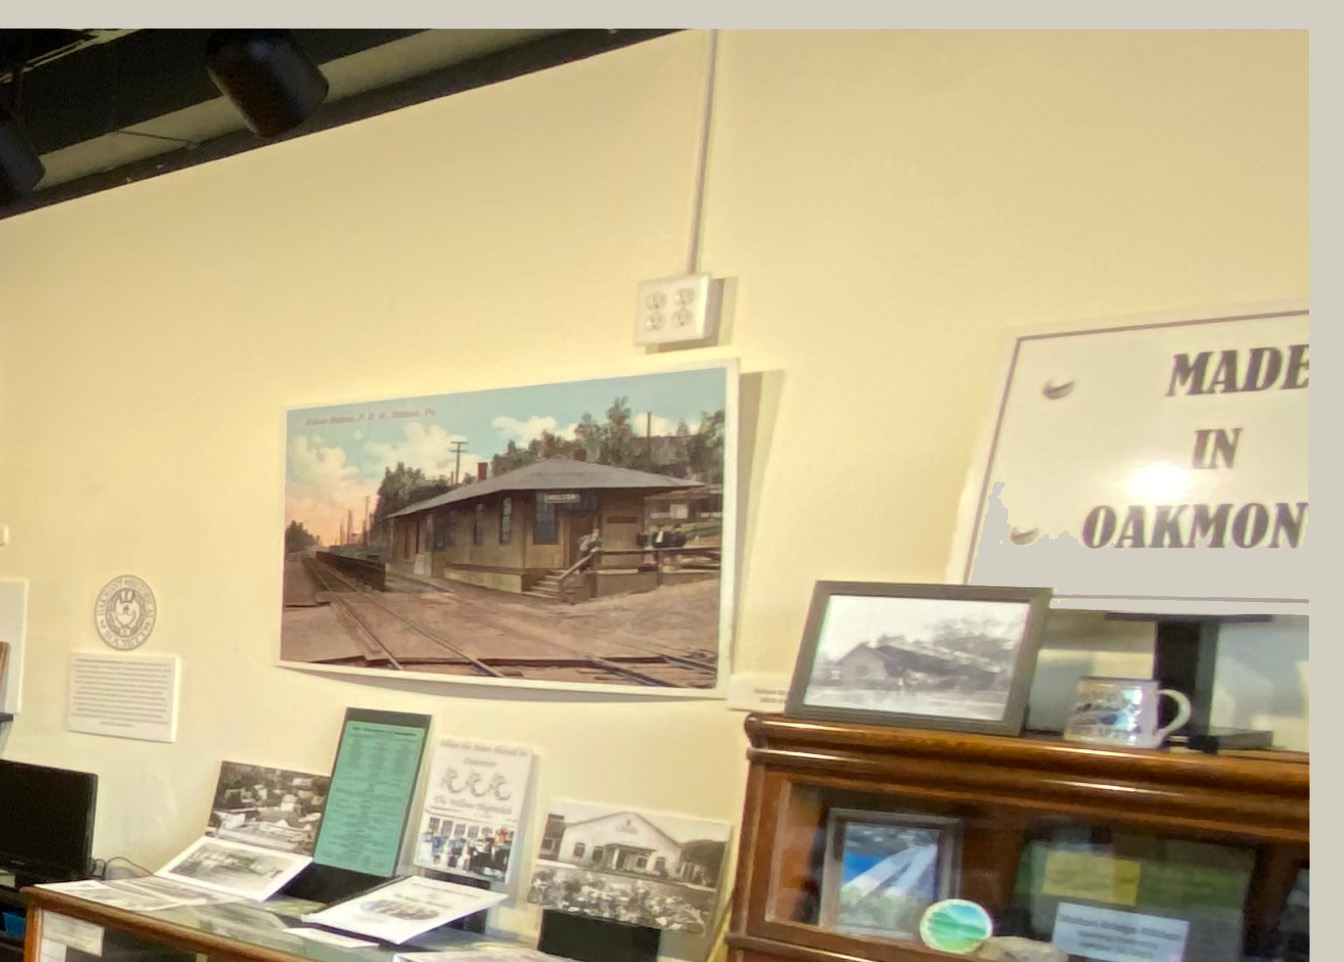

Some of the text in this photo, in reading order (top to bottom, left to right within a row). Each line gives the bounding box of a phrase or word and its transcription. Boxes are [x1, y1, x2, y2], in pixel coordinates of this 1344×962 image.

[1165, 343, 1310, 397] MADE
[1191, 428, 1244, 470] IN
[1081, 501, 1309, 549] OAKMON
